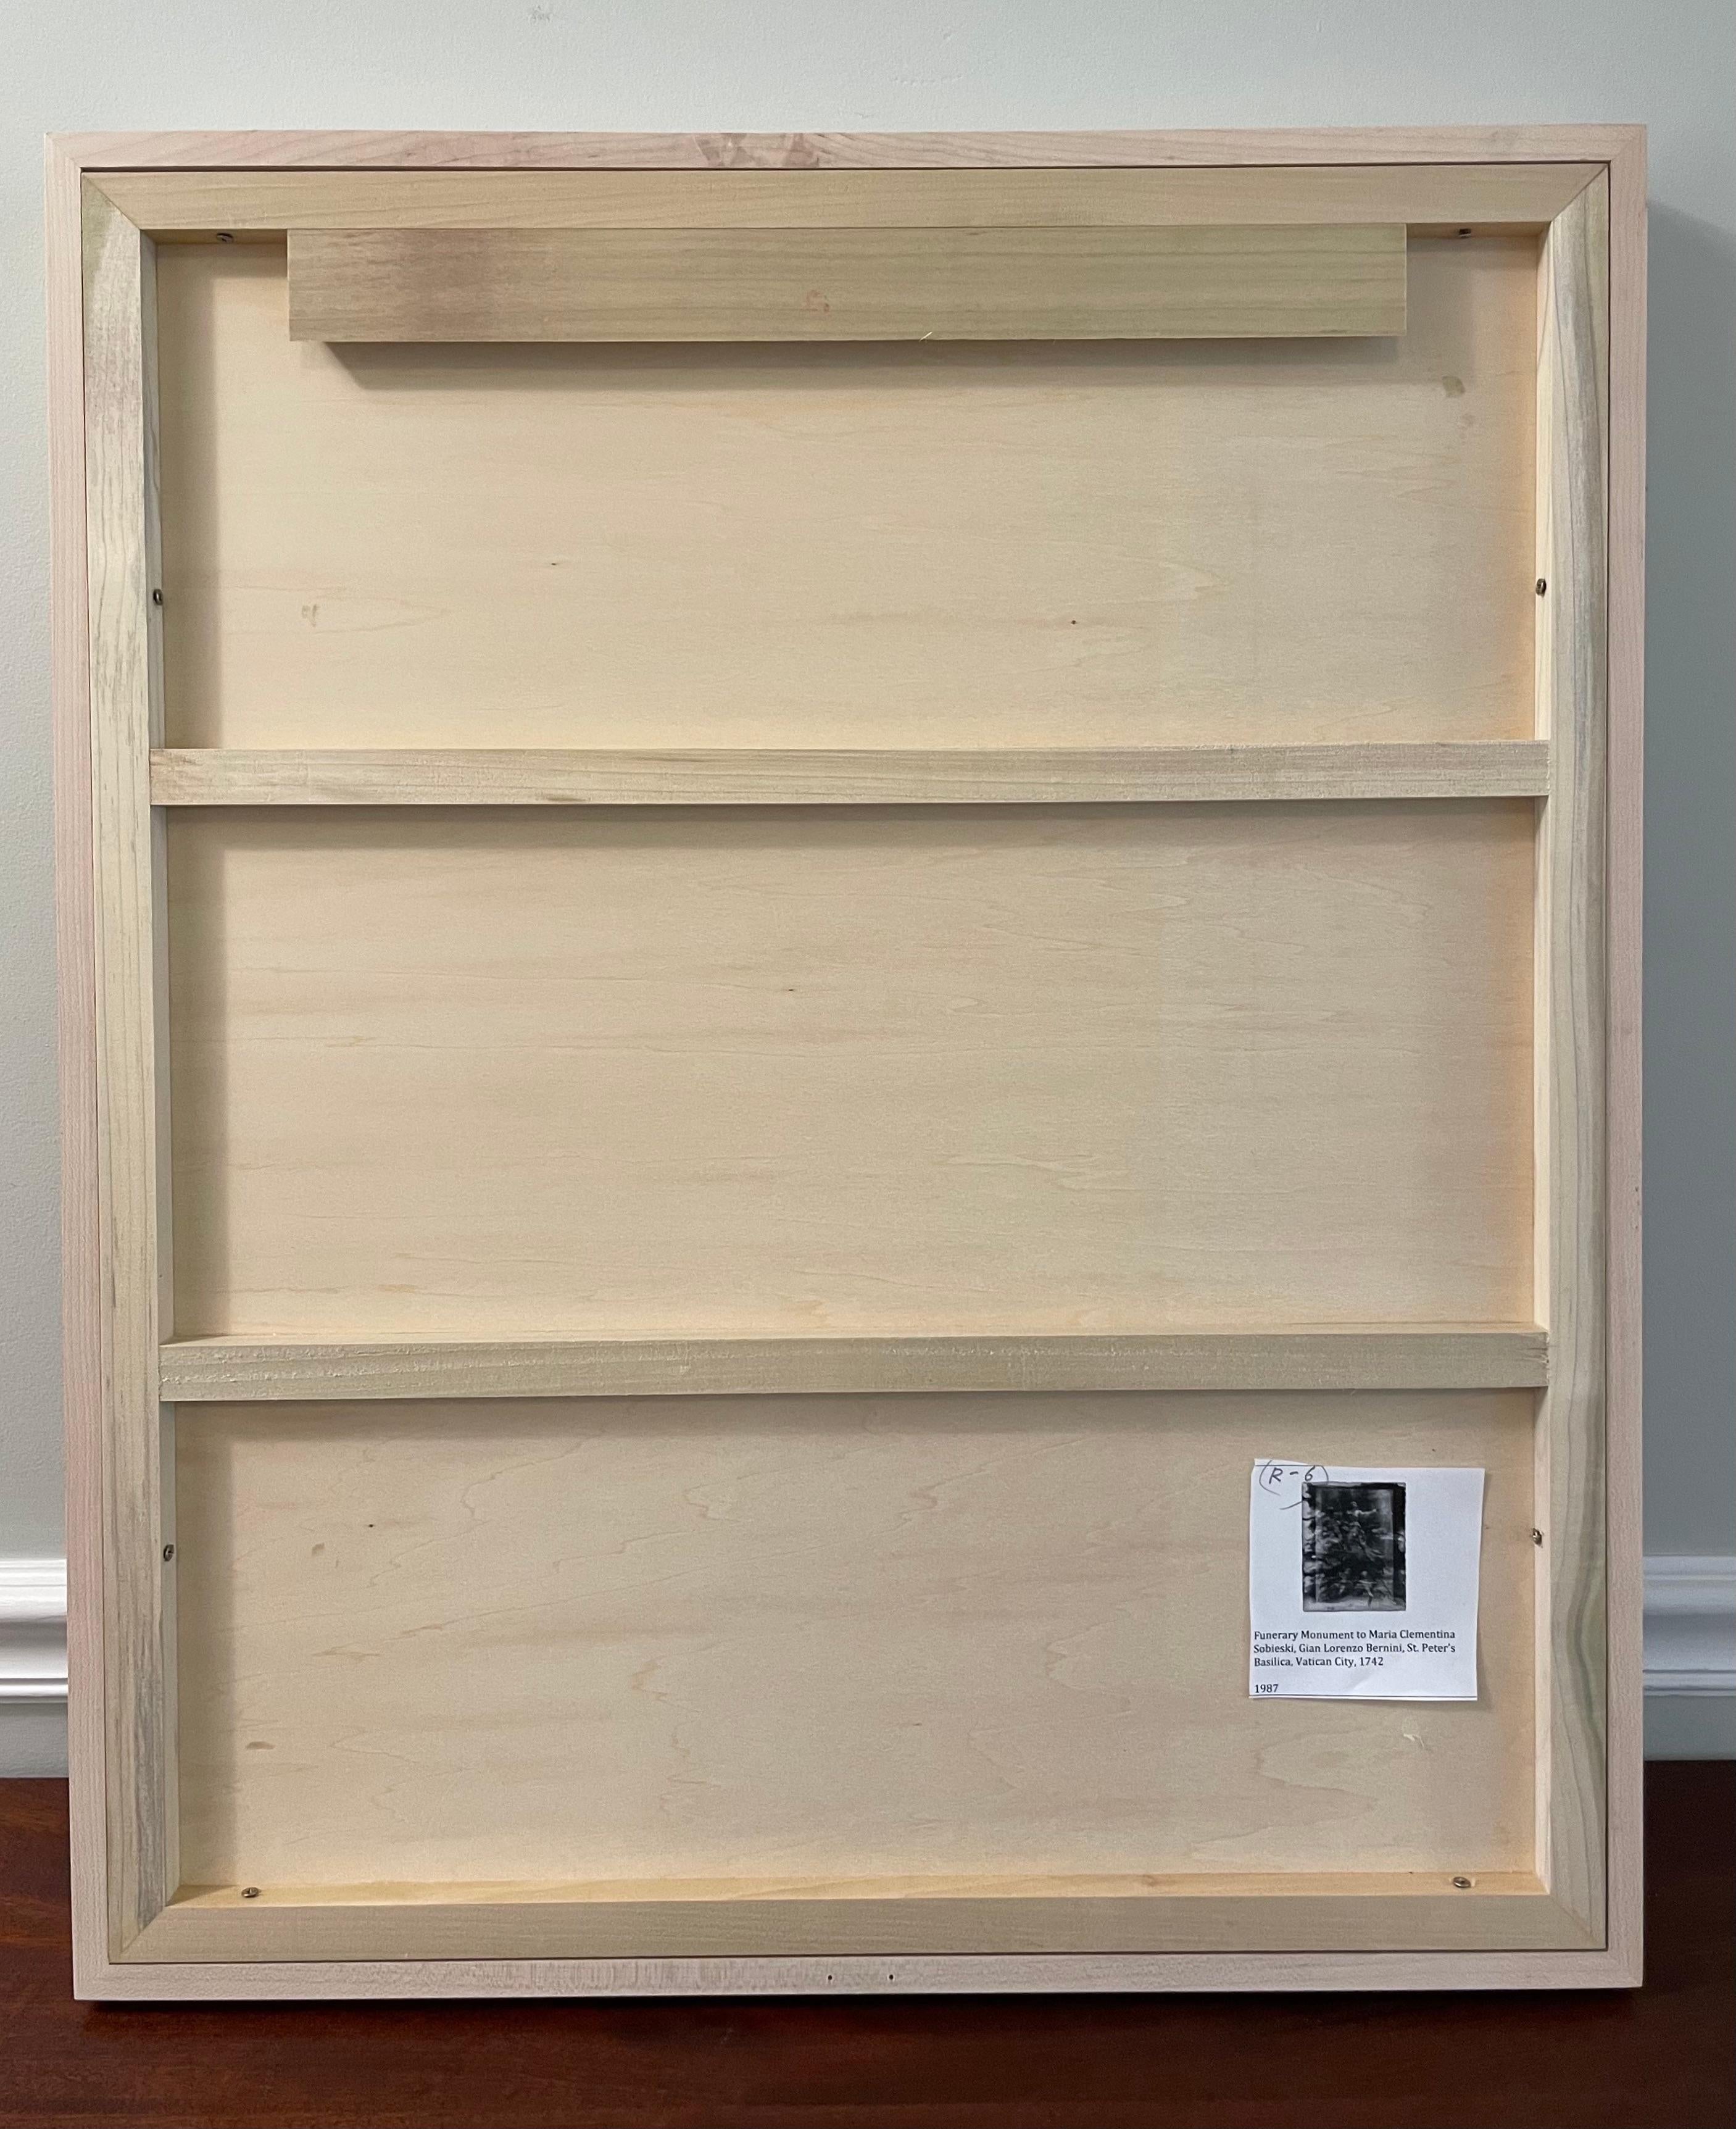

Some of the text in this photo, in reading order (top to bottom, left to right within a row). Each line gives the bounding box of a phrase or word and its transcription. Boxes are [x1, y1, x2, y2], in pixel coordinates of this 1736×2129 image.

[1254, 1630, 1455, 1641] Funerary Monument to Maria Clementina
[1254, 1643, 1456, 1654] Sobieski, Gian Lorenzo Bernini, St. Peter's
[1254, 1657, 1384, 1668] Basilica, Vatican City, 1742
[1255, 1684, 1278, 1693] 1987
